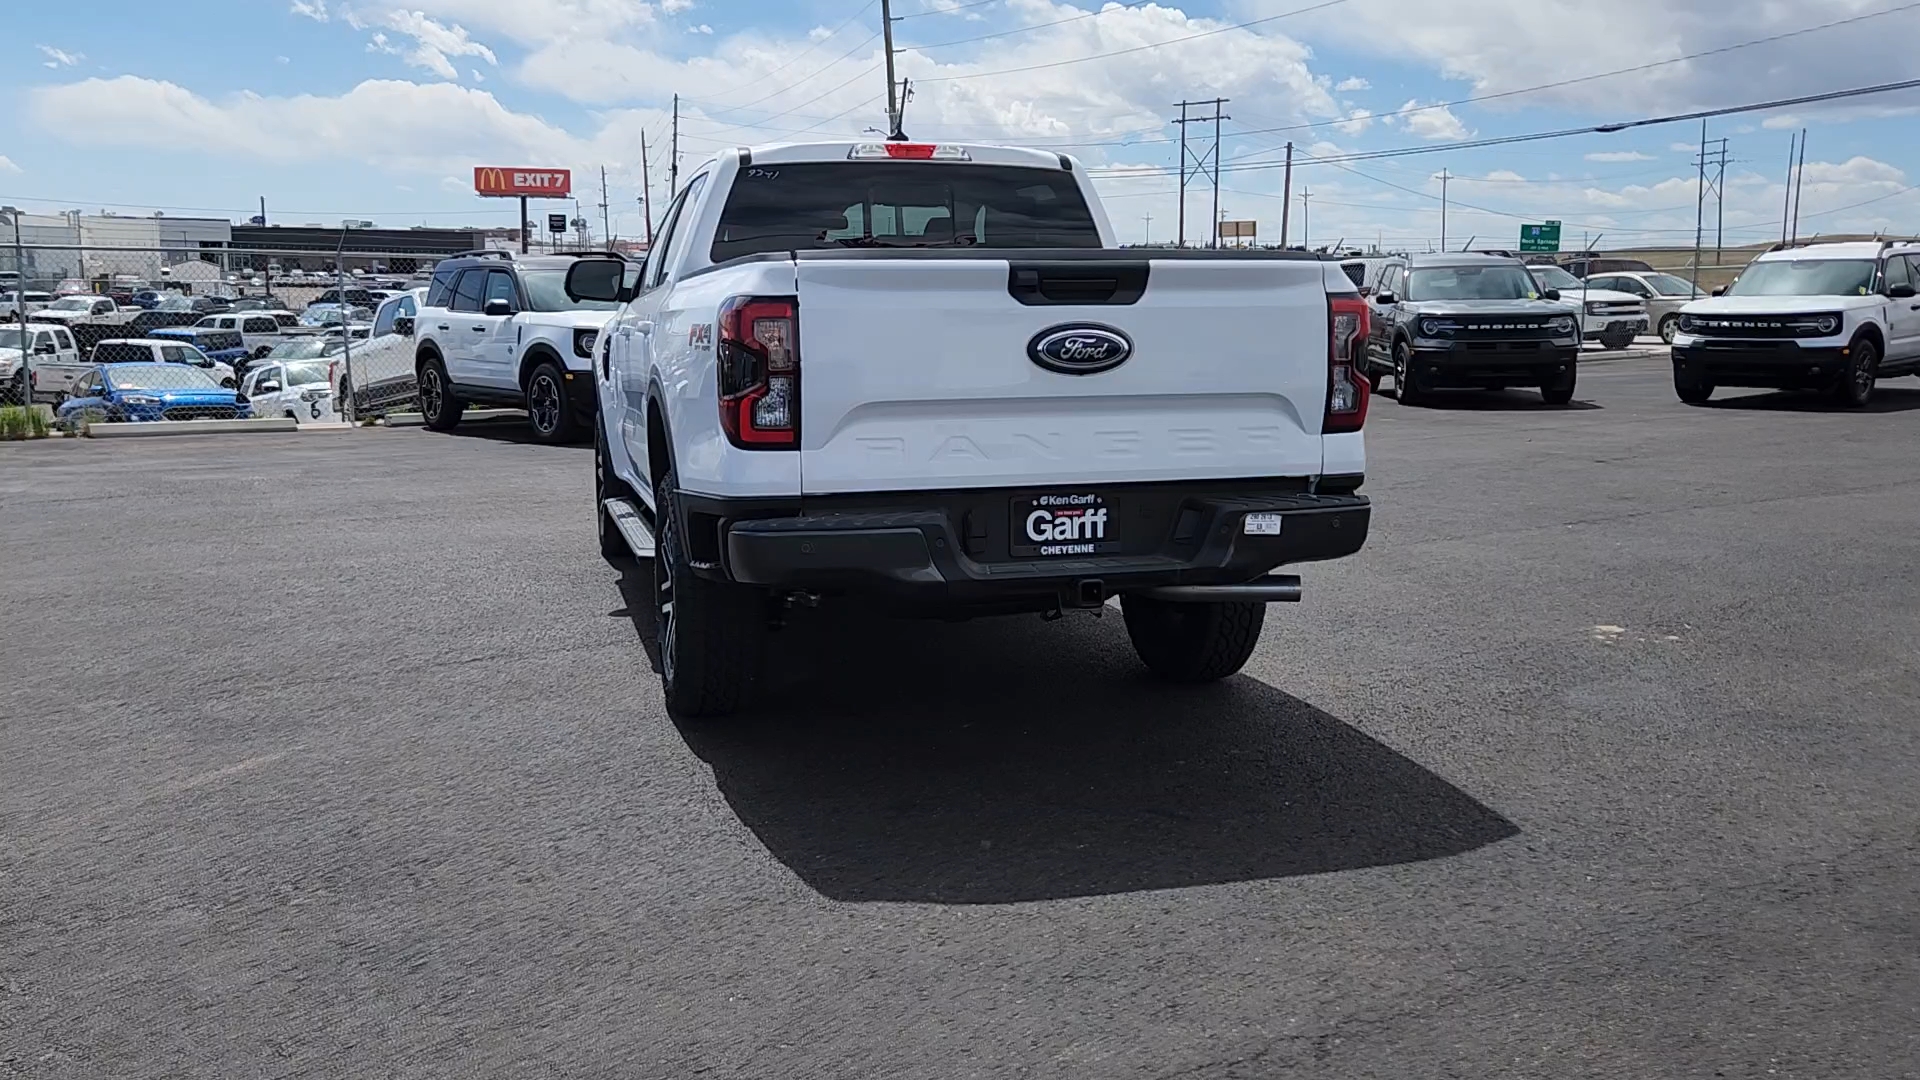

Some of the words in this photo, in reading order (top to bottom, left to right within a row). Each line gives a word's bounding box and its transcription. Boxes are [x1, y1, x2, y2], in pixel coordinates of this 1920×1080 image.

[513, 172, 551, 187] EXIT
[555, 174, 564, 188] 7
[688, 323, 711, 346] FX4
[1060, 337, 1109, 359] Ford
[1049, 496, 1069, 505] Ken
[1070, 494, 1095, 504] Garff
[1026, 507, 1107, 542] Garff
[1040, 544, 1095, 555] CHEYENNE
